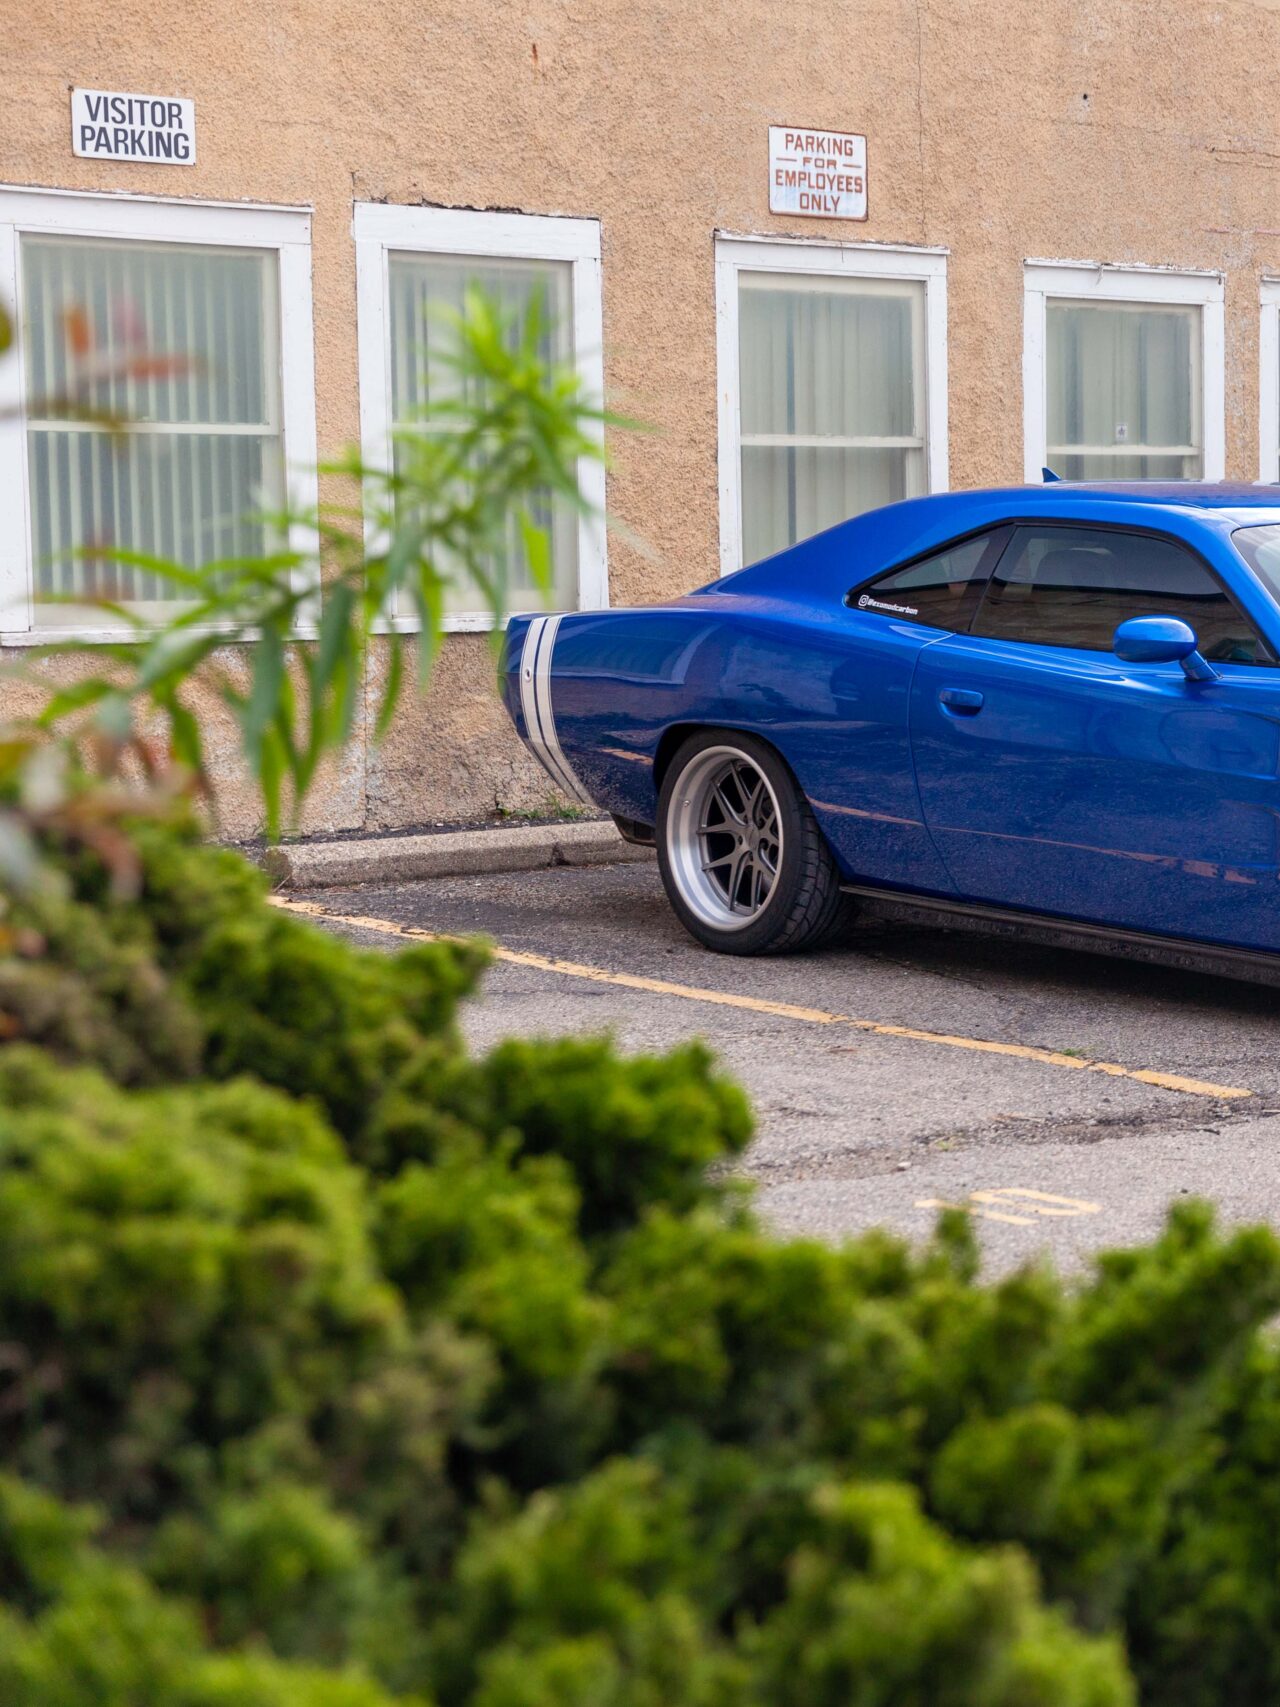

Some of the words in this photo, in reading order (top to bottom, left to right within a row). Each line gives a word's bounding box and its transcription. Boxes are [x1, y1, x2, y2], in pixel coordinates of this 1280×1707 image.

[84, 94, 183, 129] VISITOR
[80, 125, 190, 160] PARKING
[785, 133, 853, 157] PARKING
[802, 156, 837, 170] FOR
[775, 169, 863, 194] EMPLOYEES
[799, 192, 841, 213] ONLY
